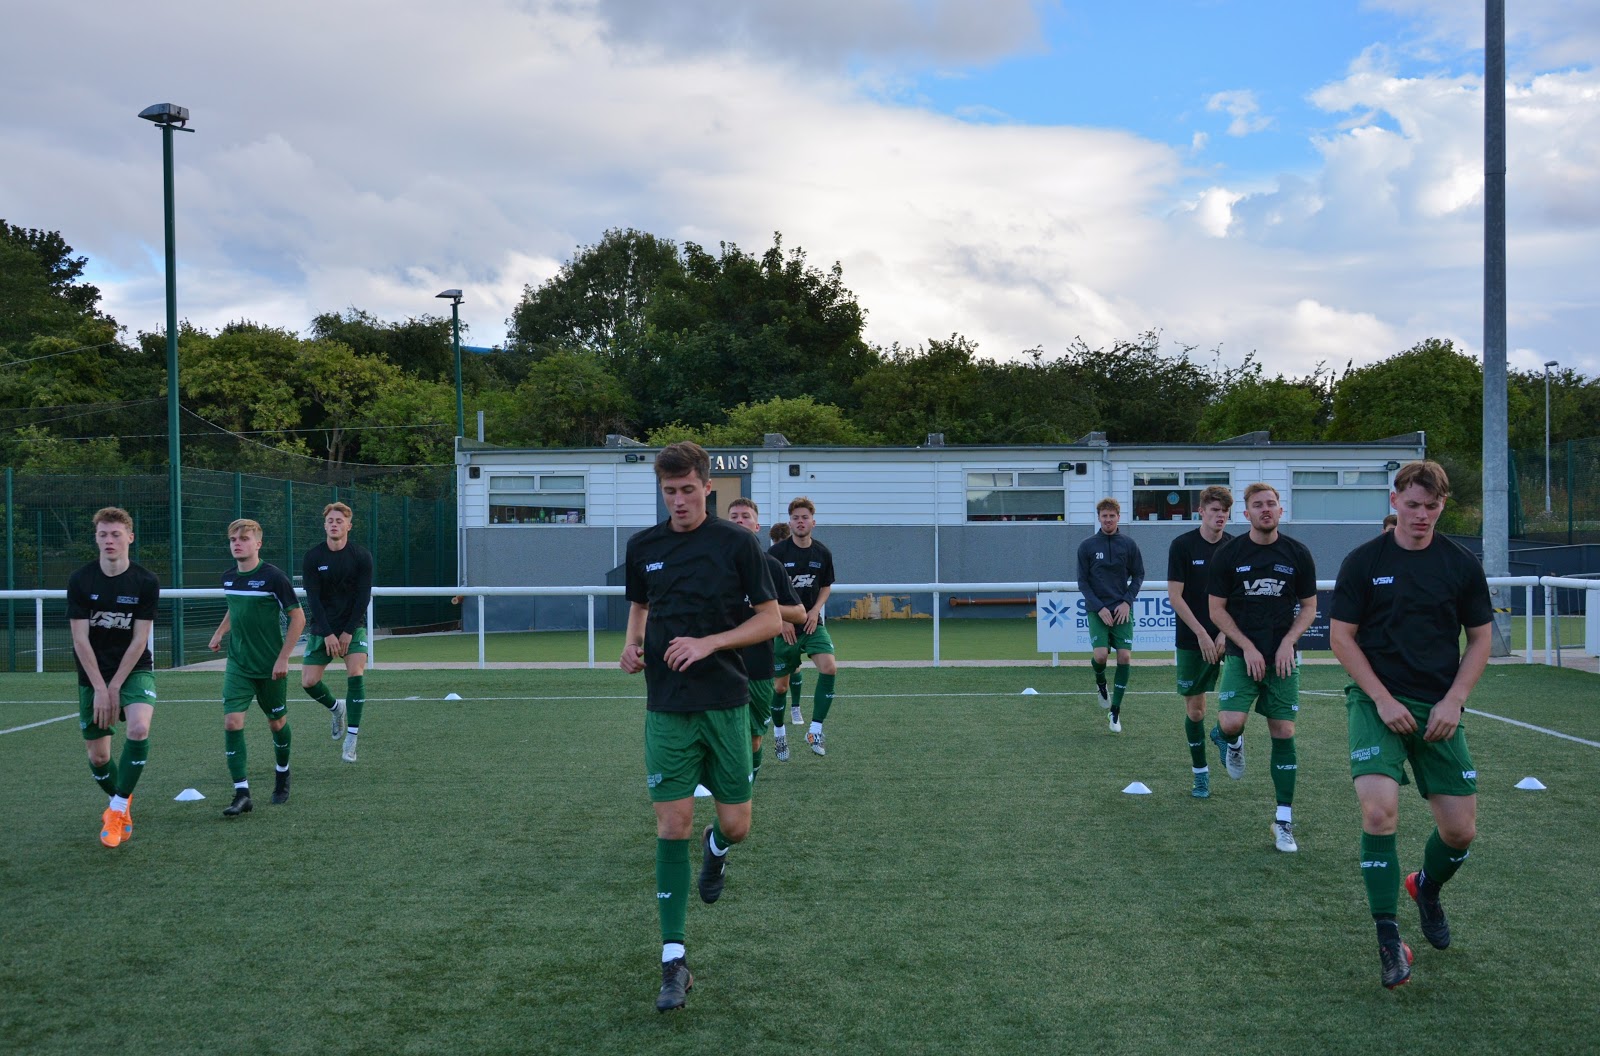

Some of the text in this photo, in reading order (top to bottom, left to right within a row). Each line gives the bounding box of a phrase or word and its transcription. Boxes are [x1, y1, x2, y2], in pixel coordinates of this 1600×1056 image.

[1095, 552, 1104, 560] 20
[645, 561, 664, 572] VSN
[1236, 565, 1251, 573] VSN
[1243, 578, 1286, 592] VSN
[1372, 576, 1394, 585] VSN
[90, 610, 133, 626] VSN
[1139, 617, 1176, 628] SOCIE
